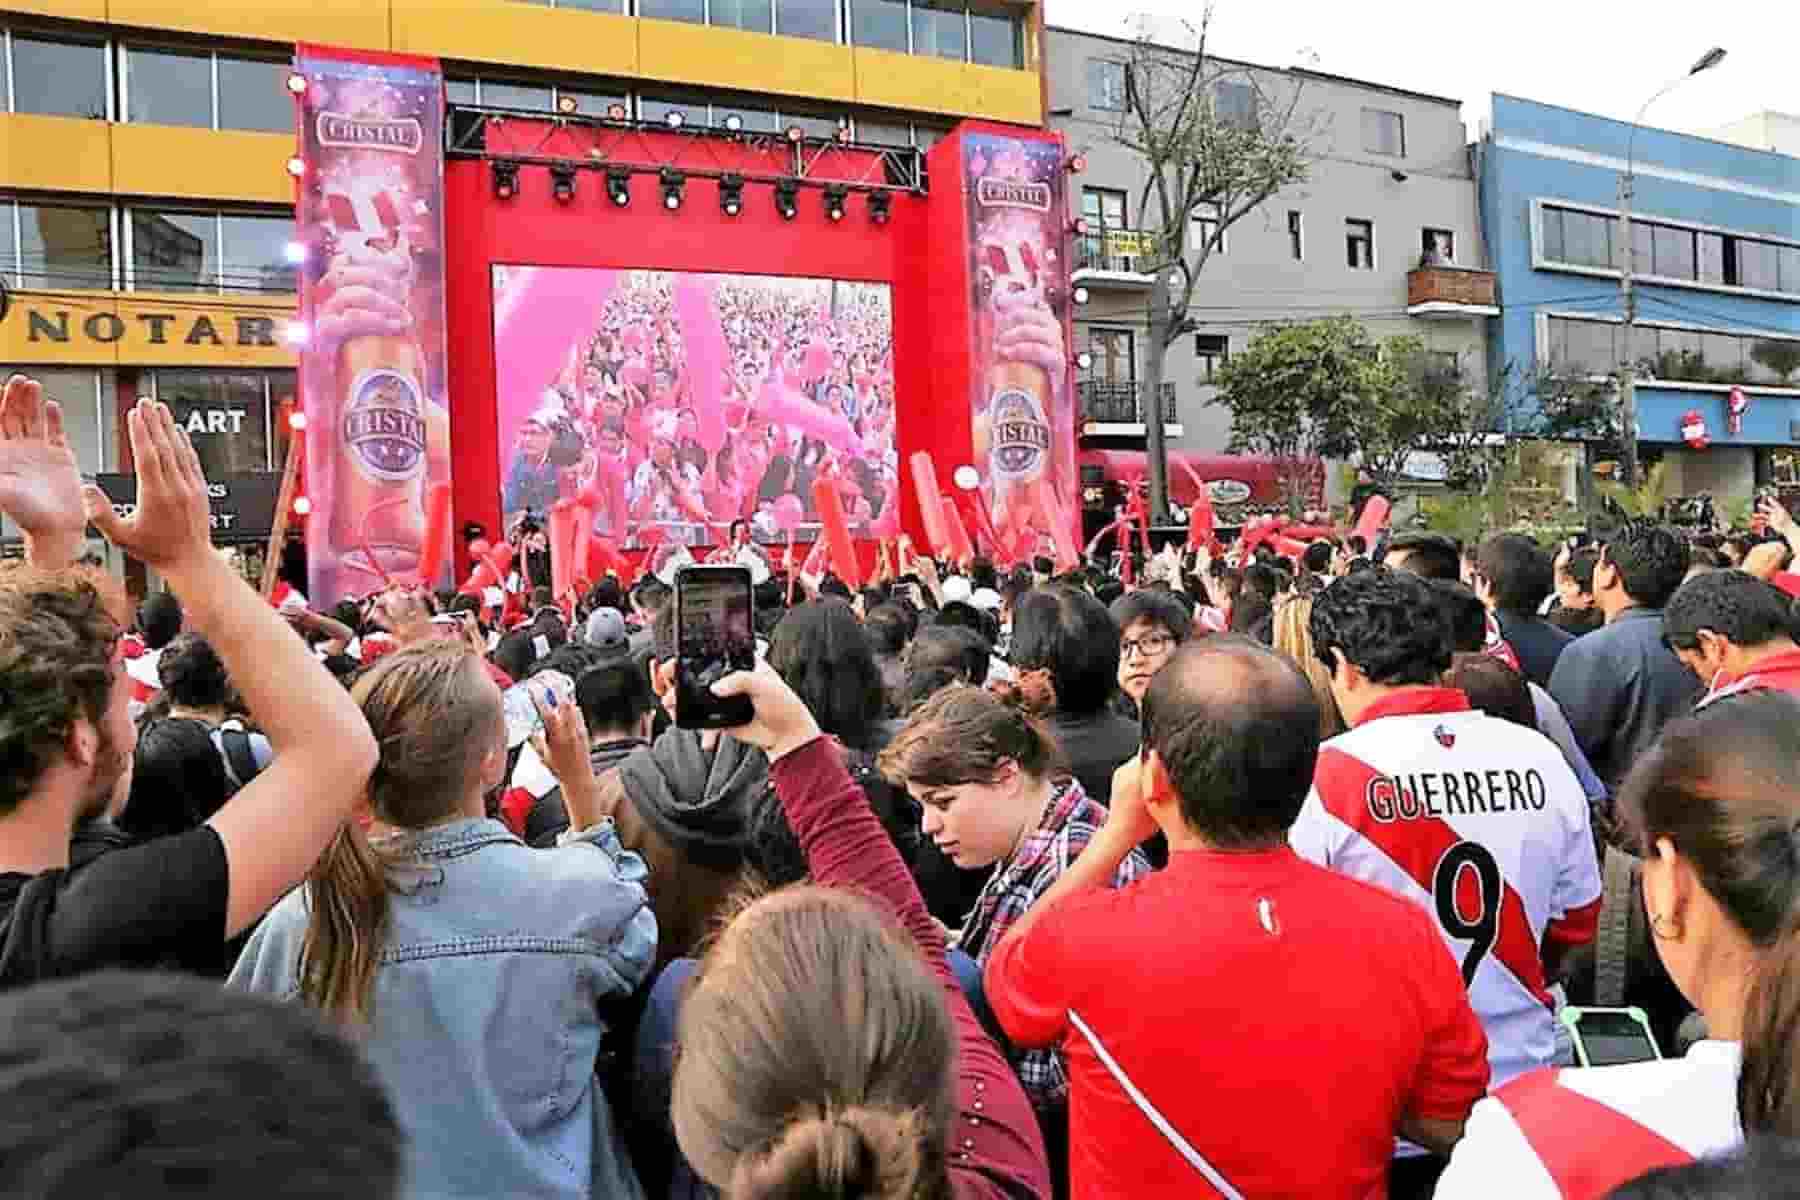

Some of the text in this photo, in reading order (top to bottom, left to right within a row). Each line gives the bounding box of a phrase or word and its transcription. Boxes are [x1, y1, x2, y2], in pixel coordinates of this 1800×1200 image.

[27, 309, 277, 346] NOTAR
[1369, 768, 1546, 821] GUERRERO
[1433, 840, 1502, 991] 9
